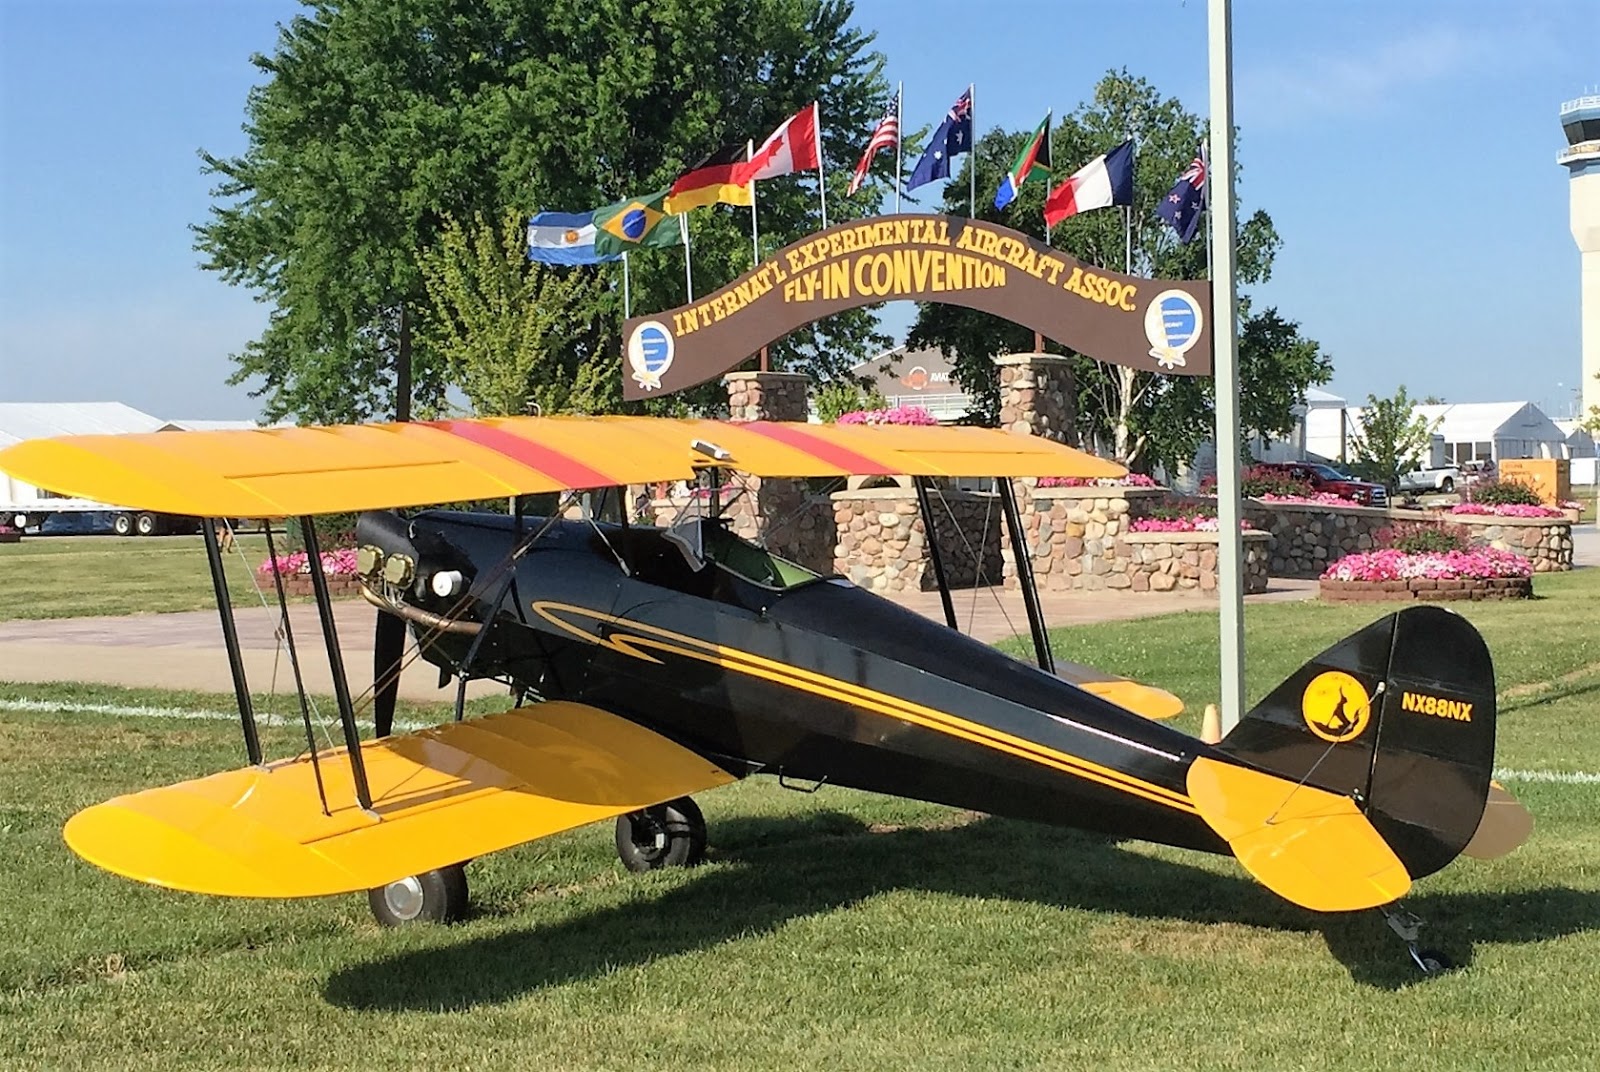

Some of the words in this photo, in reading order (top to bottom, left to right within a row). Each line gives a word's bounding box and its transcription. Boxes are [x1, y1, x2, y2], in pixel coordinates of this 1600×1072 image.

[673, 261, 787, 337] INTERNAT'L
[786, 220, 950, 274] EXPERIMENTAL
[956, 226, 1064, 285] AIRCRAFT
[784, 259, 849, 302] FLY-IN
[854, 250, 1006, 296] CONVENTION
[1402, 692, 1472, 721] NX88NX
